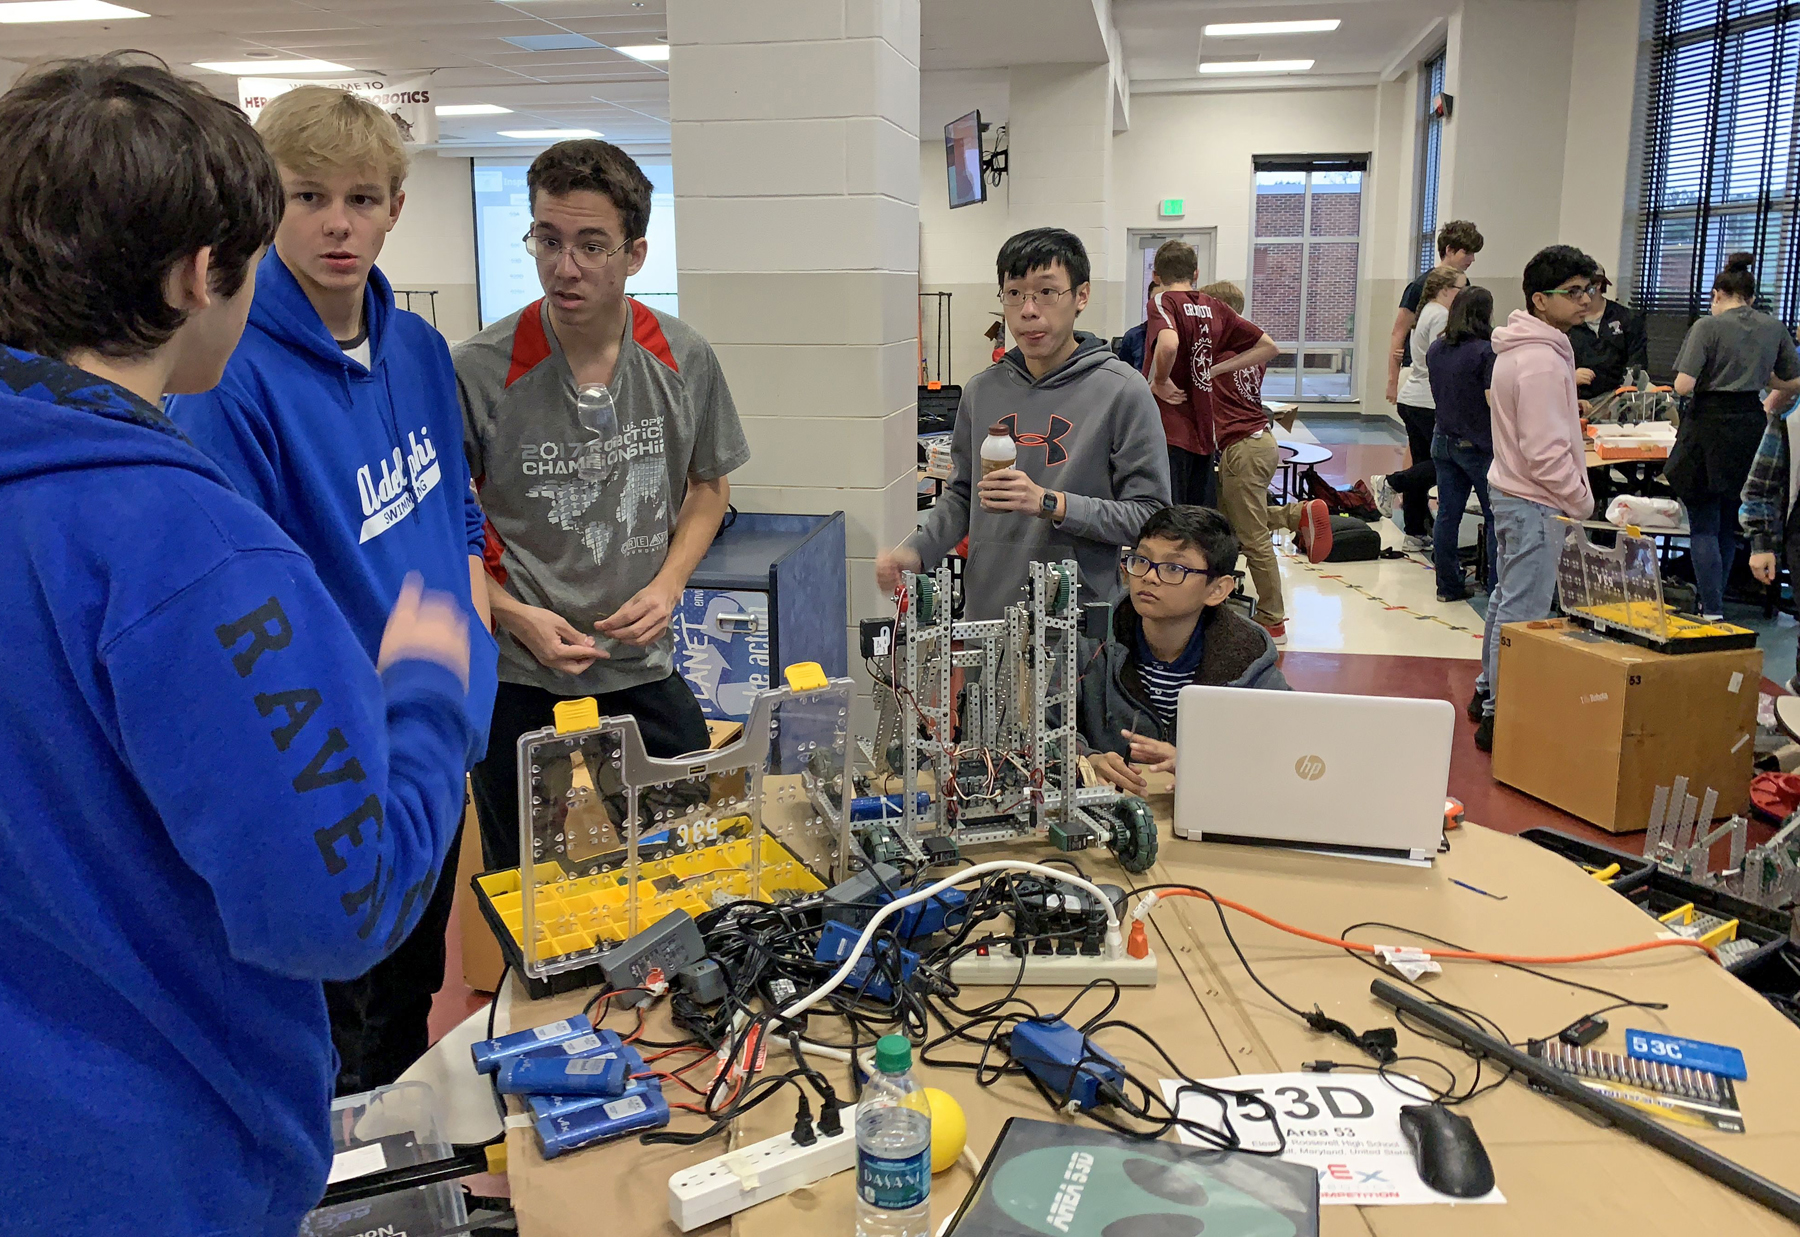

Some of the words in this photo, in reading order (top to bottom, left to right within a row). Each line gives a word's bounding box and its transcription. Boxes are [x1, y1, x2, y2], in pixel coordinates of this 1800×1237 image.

[364, 81, 384, 91] TO
[521, 442, 583, 460] 2017
[1500, 637, 1512, 648] 53
[1628, 675, 1642, 686] 53
[1299, 755, 1323, 780] hp
[676, 817, 718, 847] 53C
[1632, 1036, 1682, 1059] 53C
[1236, 1086, 1375, 1122] 53D
[1286, 1128, 1329, 1138] Area
[1334, 1127, 1356, 1138] 53
[864, 1168, 920, 1190] DASANI
[1319, 1164, 1389, 1183] EX
